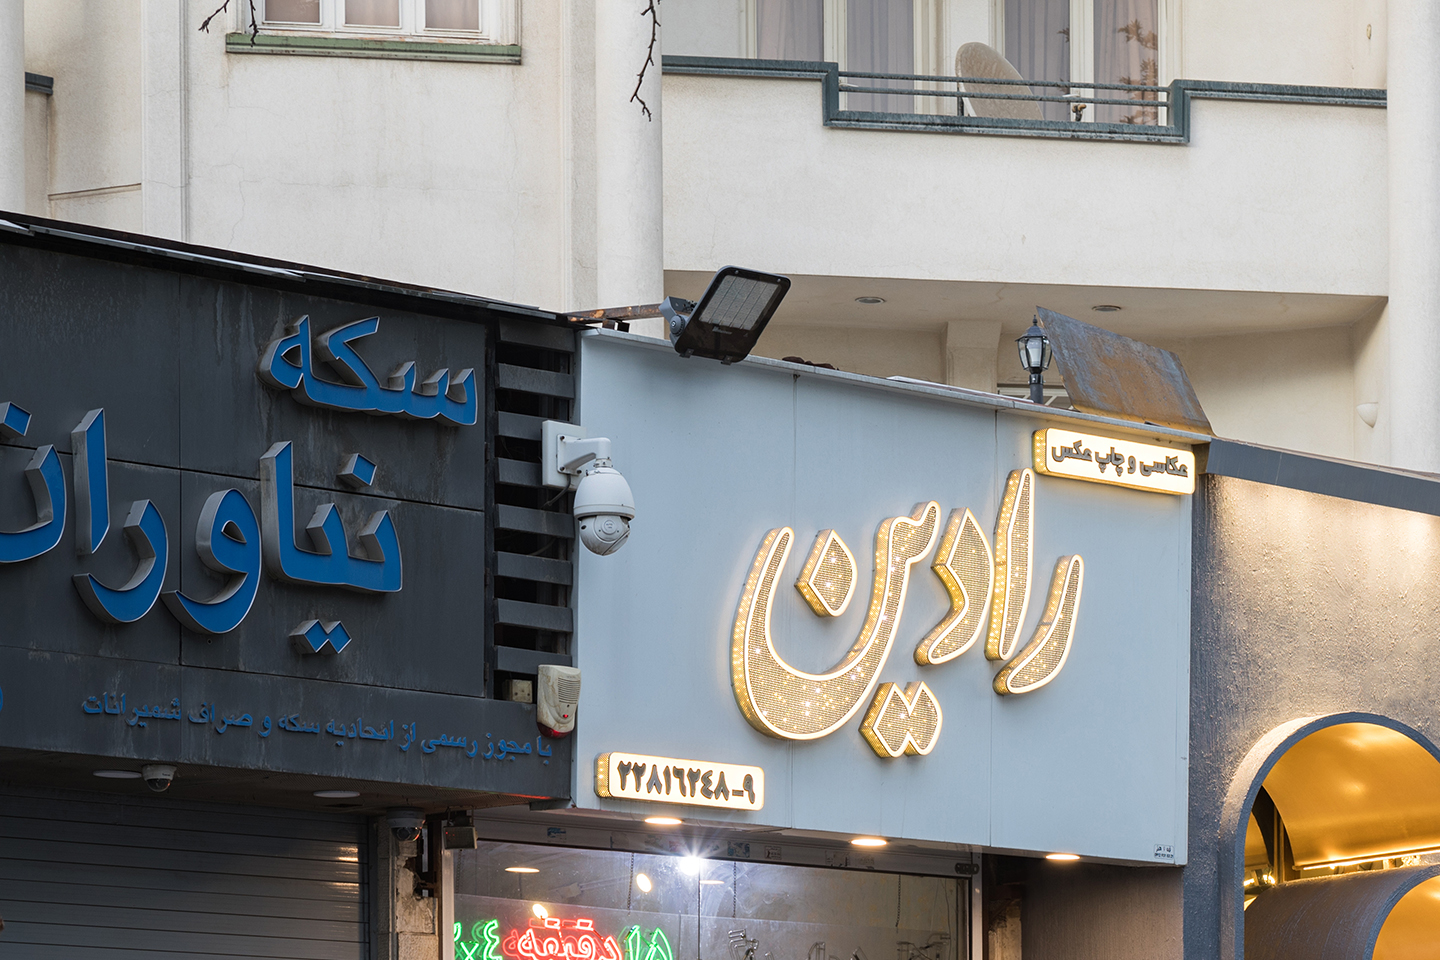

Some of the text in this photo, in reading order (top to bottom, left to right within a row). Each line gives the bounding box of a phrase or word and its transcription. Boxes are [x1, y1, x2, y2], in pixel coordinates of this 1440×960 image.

[257, 315, 477, 425] سکه
[1051, 440, 1188, 477] عکاسی و چاپ عکس
[0, 402, 402, 655] نیاوران
[731, 467, 1083, 758] رادین
[82, 693, 552, 765] با مجوز رسمی از اتحادیه سکه و صراف شمیرانات
